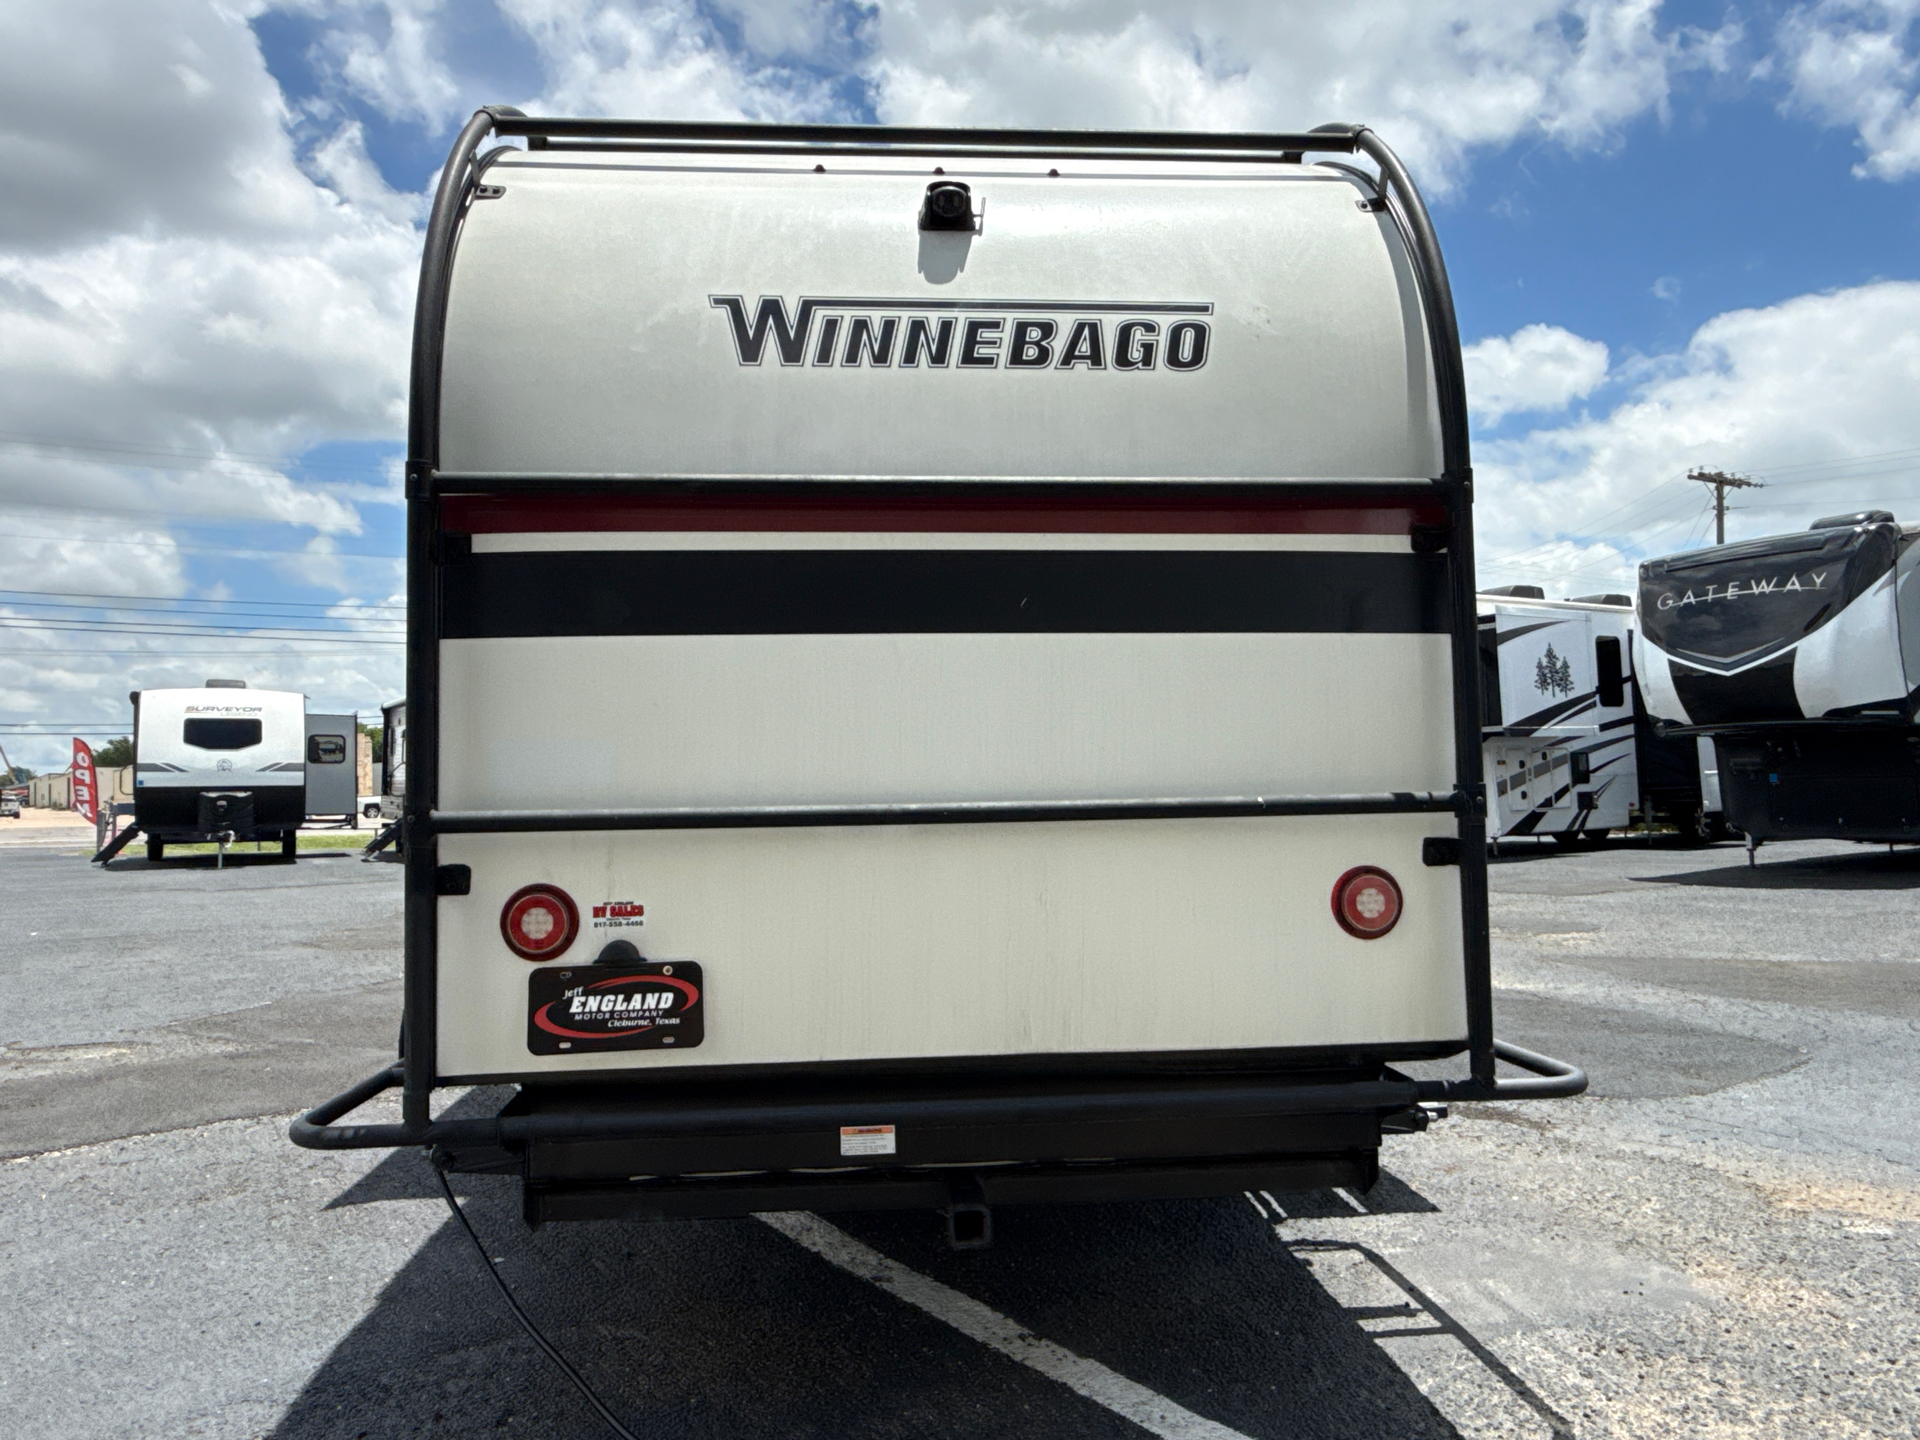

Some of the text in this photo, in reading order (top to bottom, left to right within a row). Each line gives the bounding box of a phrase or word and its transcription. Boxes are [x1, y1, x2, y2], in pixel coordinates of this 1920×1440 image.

[708, 295, 1214, 372] WINNEBAGO
[1657, 571, 1827, 611] GATEWAY
[184, 705, 263, 714] SURVEYOR
[609, 904, 644, 917] SALES
[562, 986, 584, 999] Jeff
[569, 992, 674, 1013] ENGLAND
[574, 1010, 664, 1020] MOTOR COMPANY
[655, 1017, 680, 1026] Texas
